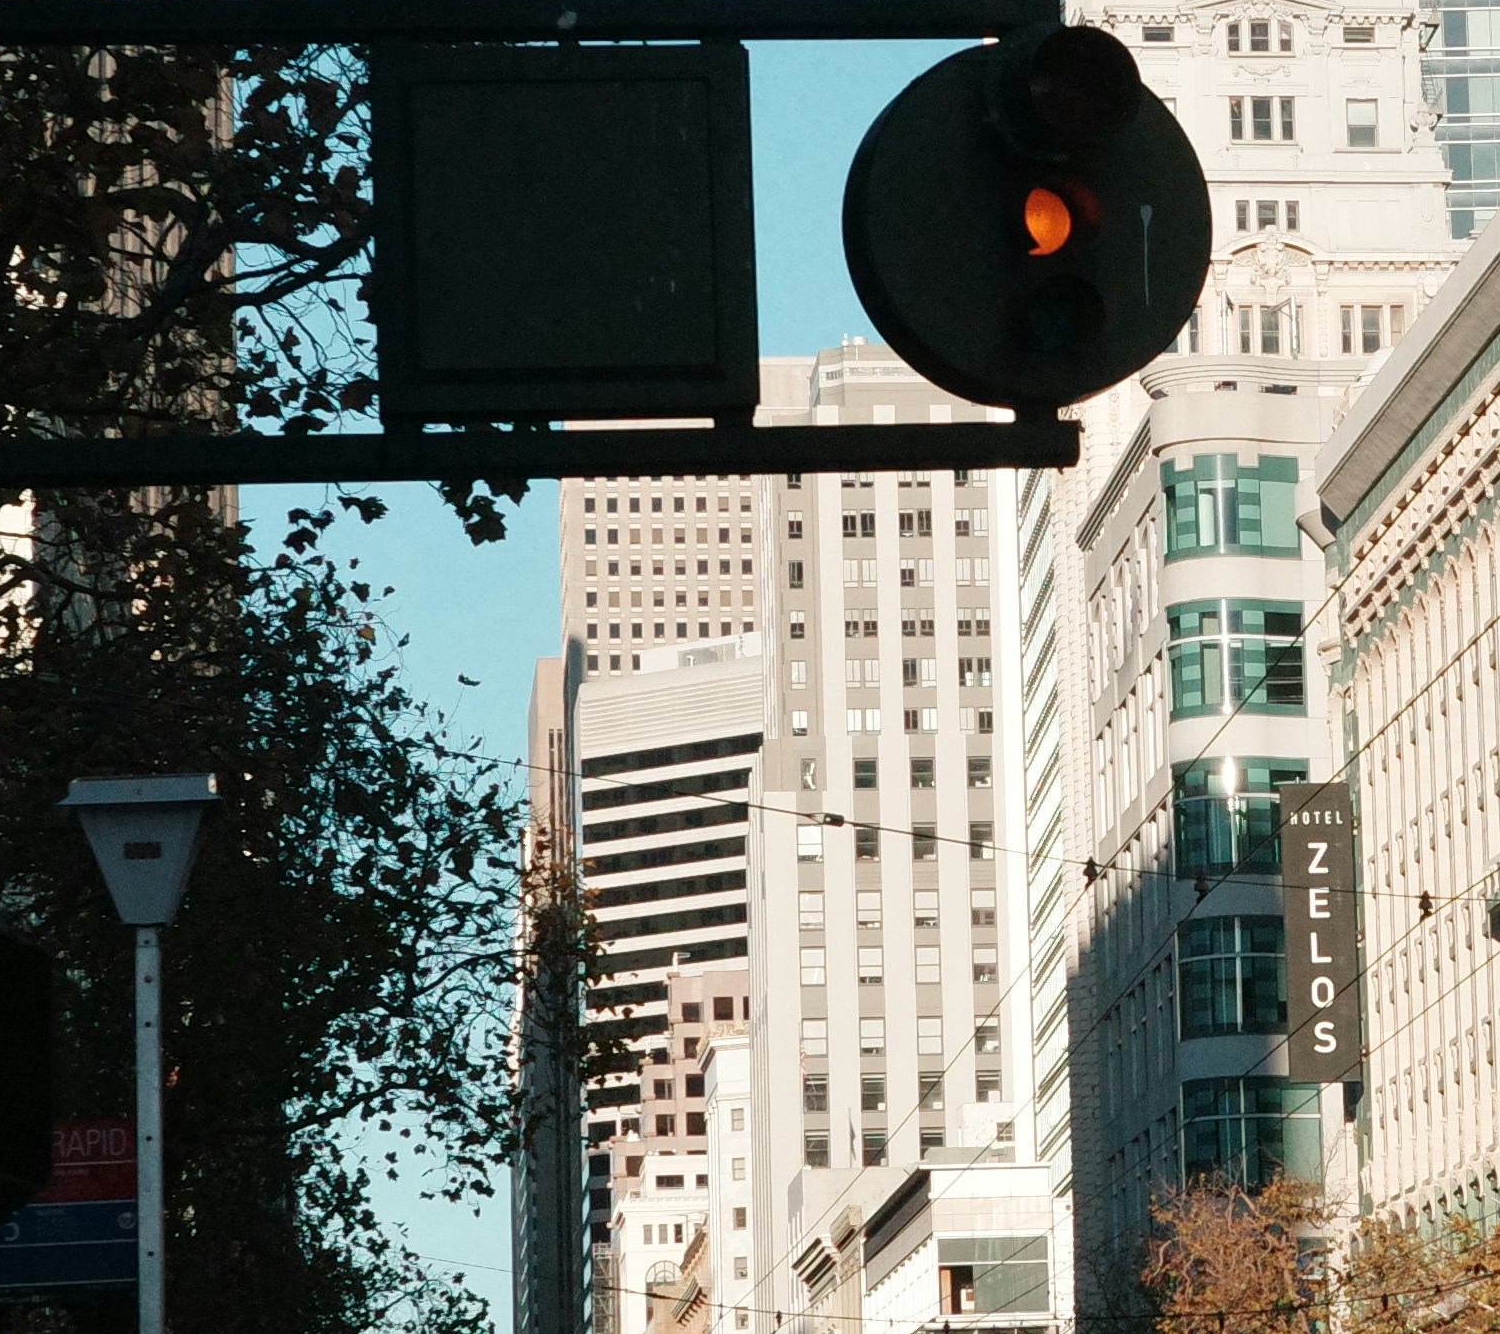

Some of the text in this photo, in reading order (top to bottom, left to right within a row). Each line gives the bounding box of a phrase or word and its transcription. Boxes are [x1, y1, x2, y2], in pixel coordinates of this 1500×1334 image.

[1290, 810, 1344, 826] HOTEL
[1306, 841, 1338, 1054] ZELOS
[51, 1127, 128, 1157] RAPID
